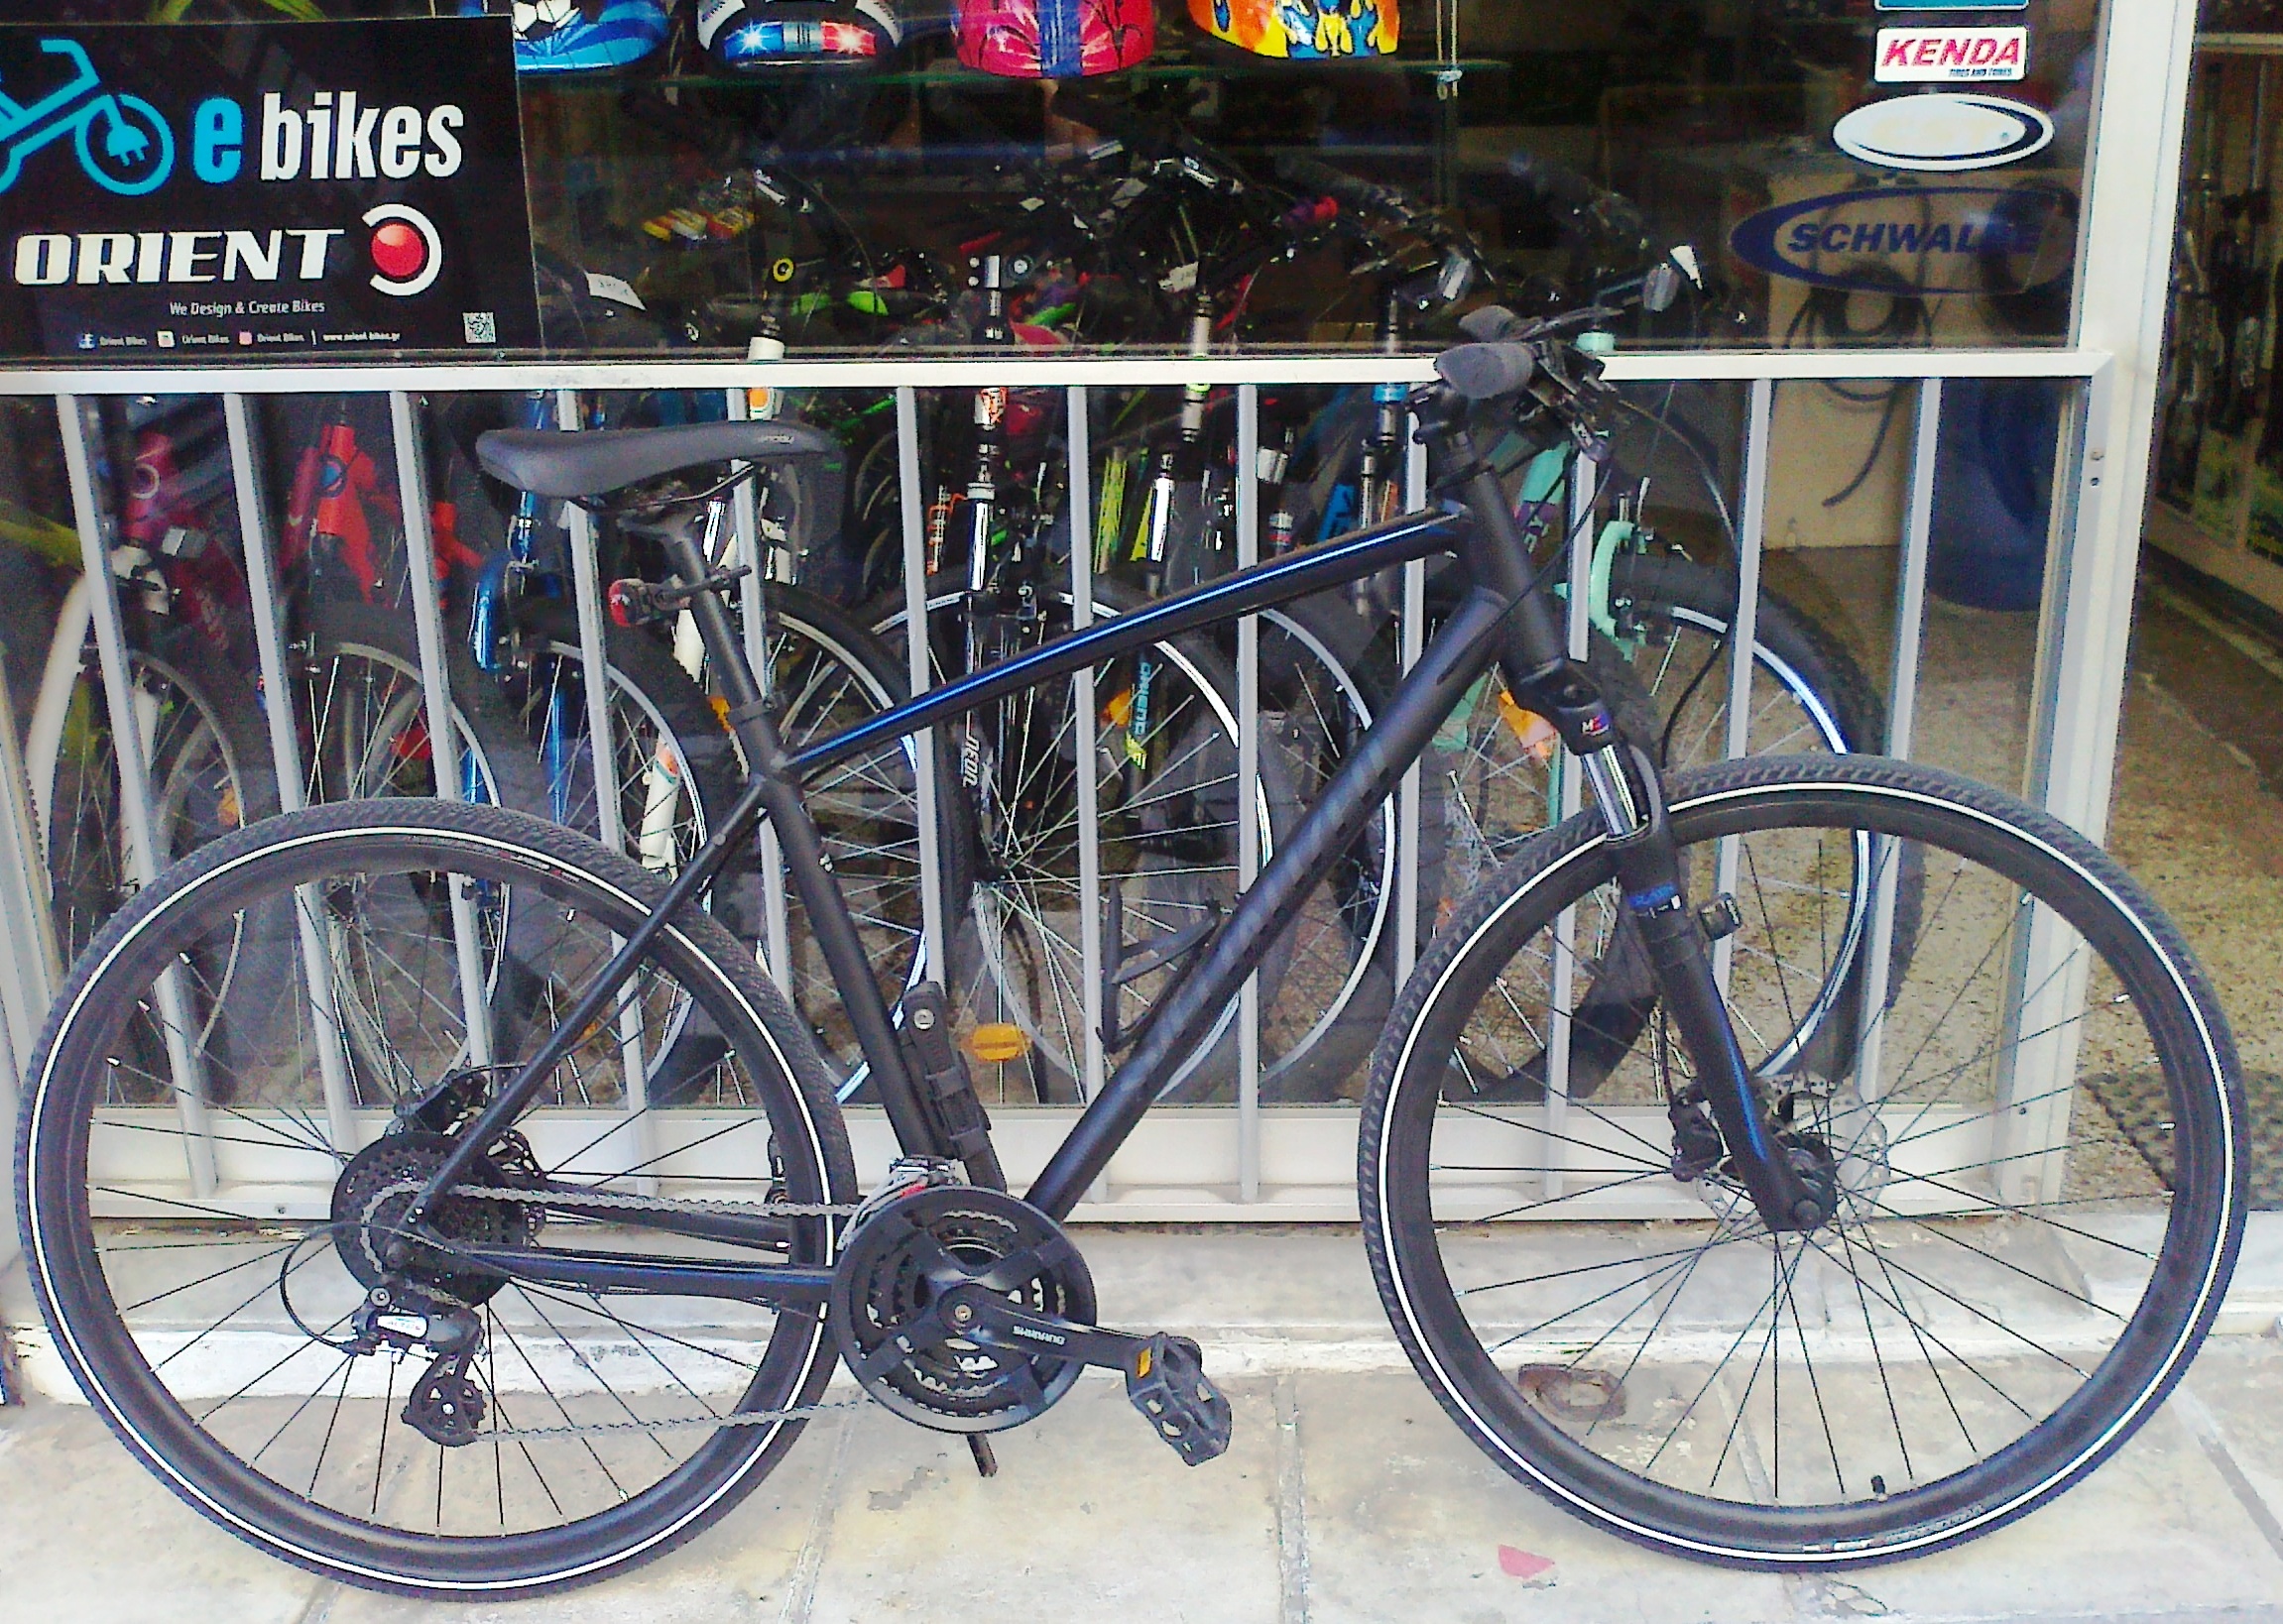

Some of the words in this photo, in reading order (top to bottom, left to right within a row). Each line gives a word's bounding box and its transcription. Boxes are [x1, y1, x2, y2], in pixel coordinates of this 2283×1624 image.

[1881, 38, 2020, 66] KENDA
[193, 96, 244, 183] e
[260, 90, 464, 180] bikes
[14, 228, 345, 286] ORIENT
[170, 301, 187, 315] We
[190, 301, 232, 317] Design
[235, 300, 245, 314] &
[248, 299, 289, 314] Create
[292, 297, 325, 312] Bikes
